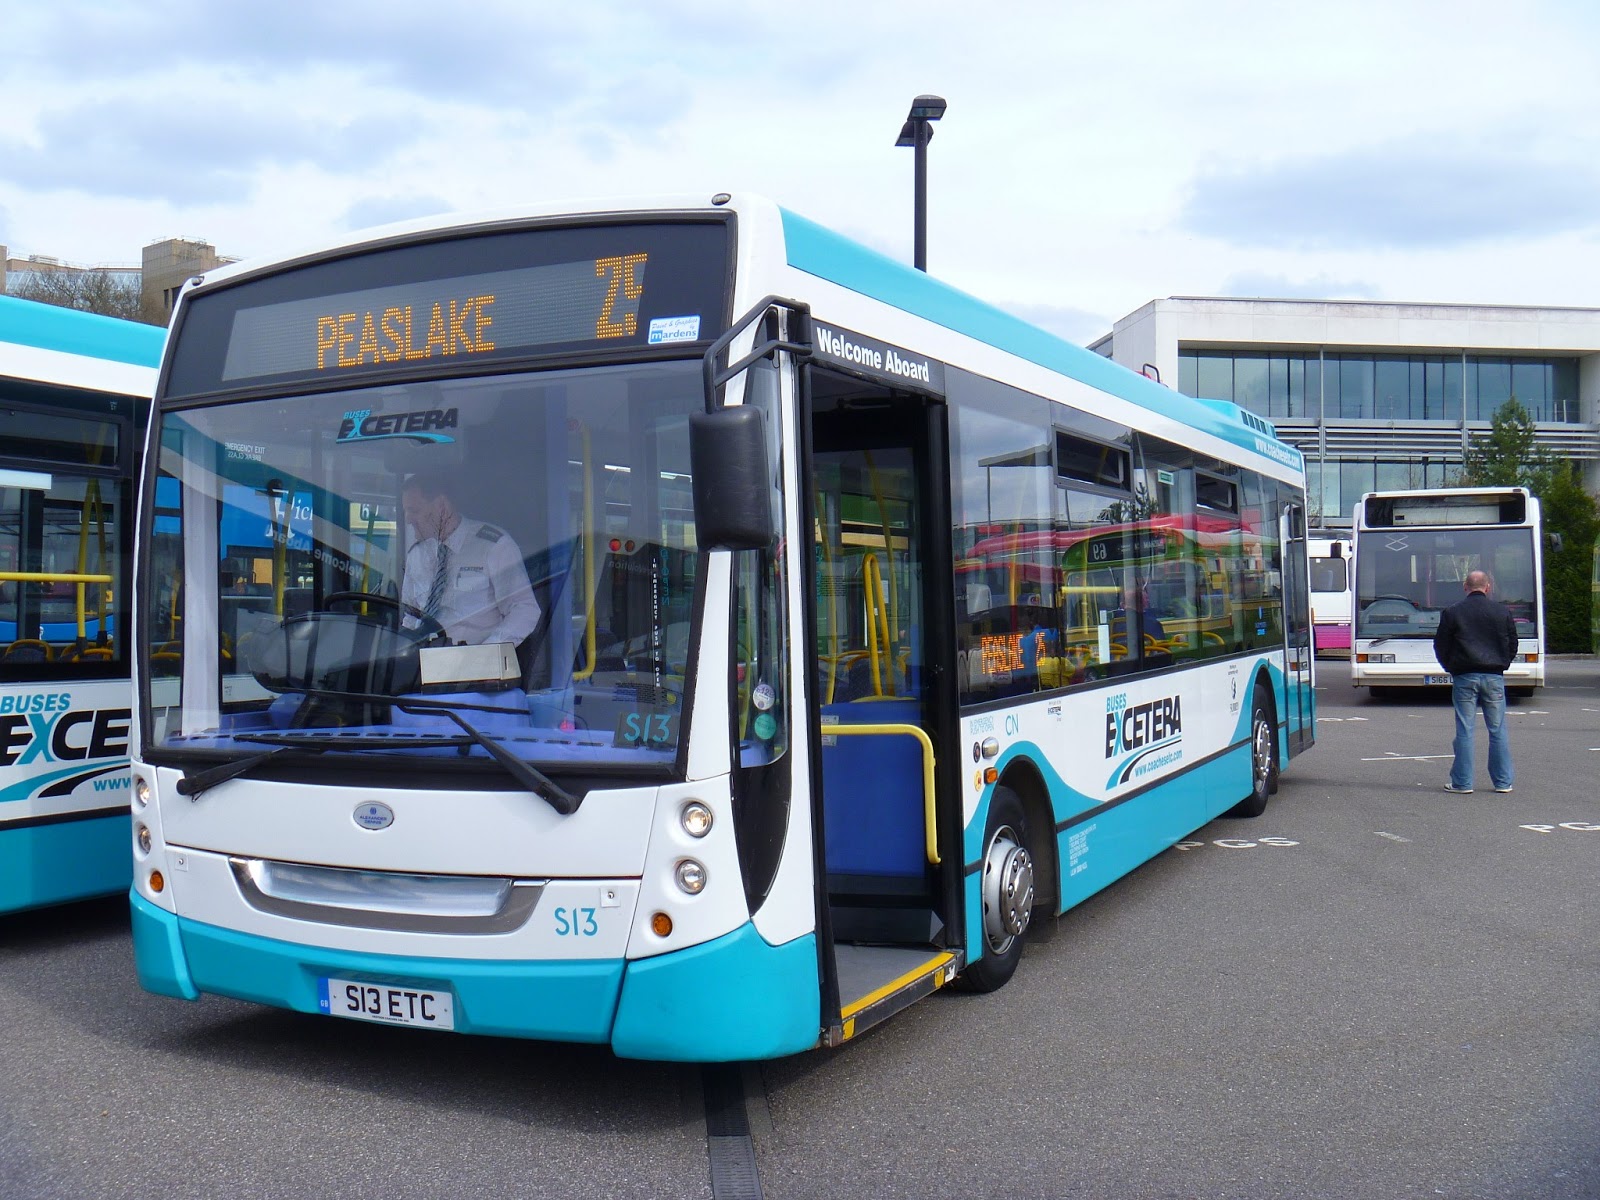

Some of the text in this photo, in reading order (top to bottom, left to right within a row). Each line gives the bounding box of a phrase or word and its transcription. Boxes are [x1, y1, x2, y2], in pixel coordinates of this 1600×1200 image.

[317, 295, 495, 369] PEASLAKE
[651, 330, 697, 341] mardens
[816, 326, 930, 382] Welcome Aboard
[337, 408, 459, 440] EXCETERA
[343, 409, 371, 419] BUSES
[655, 651, 660, 662] TO
[0, 693, 72, 714] BUSES
[1106, 693, 1127, 713] BUSES
[624, 713, 671, 742] S13
[1005, 713, 1019, 736] CN
[1105, 695, 1182, 759] EXCETERA
[554, 907, 598, 936] S13
[320, 999, 329, 1008] GB
[346, 985, 436, 1021] S13 ETC
